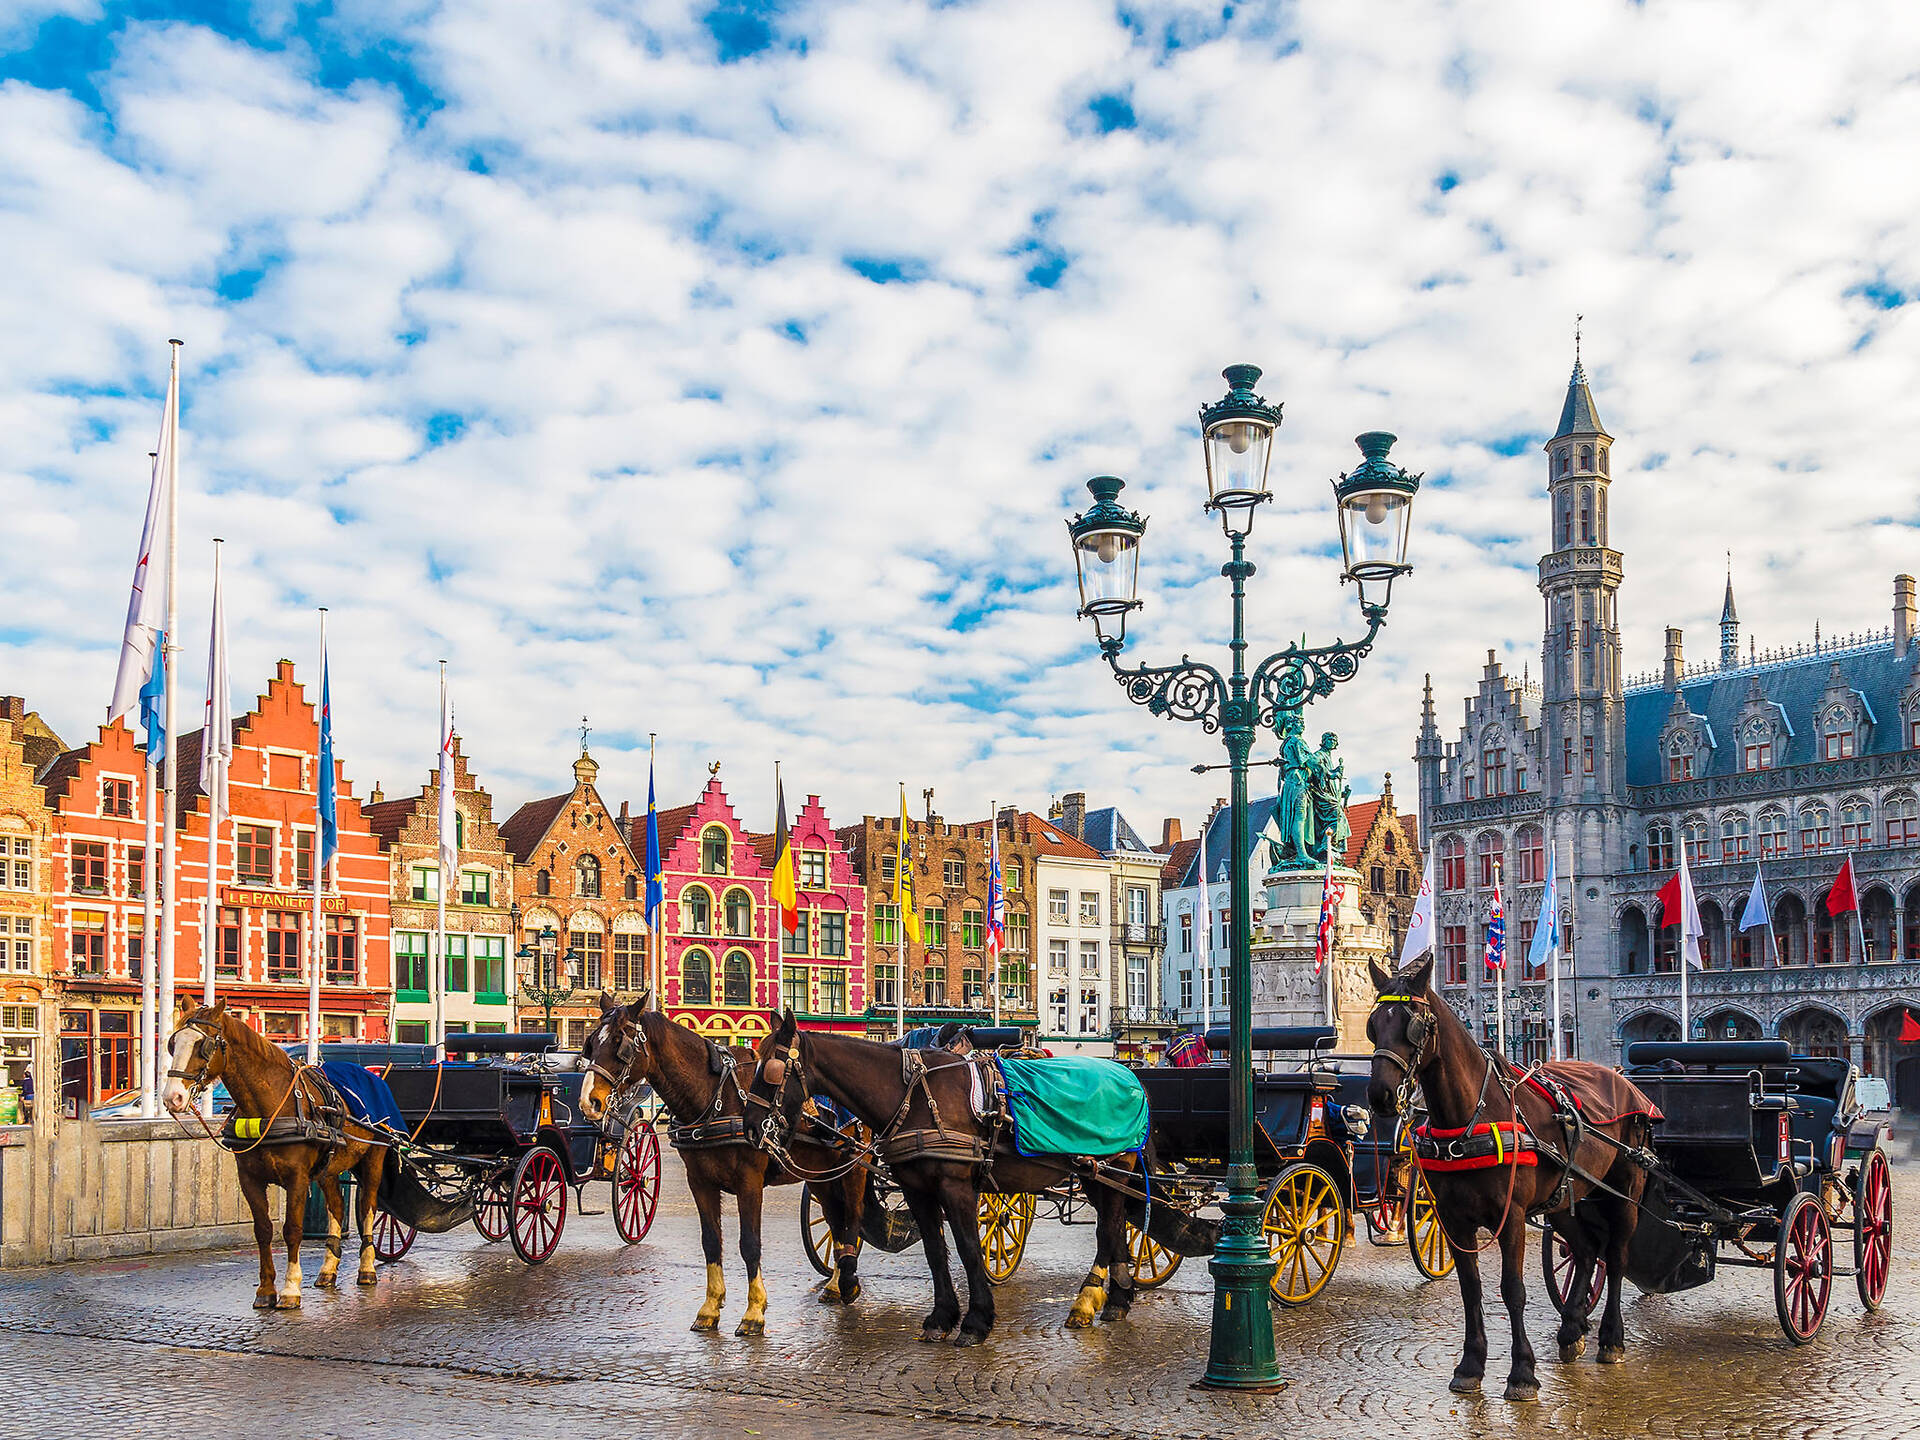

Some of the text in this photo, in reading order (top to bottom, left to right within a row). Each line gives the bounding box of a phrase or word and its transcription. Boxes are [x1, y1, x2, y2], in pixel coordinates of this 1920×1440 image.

[229, 892, 345, 911] LE PANIER 'OR
